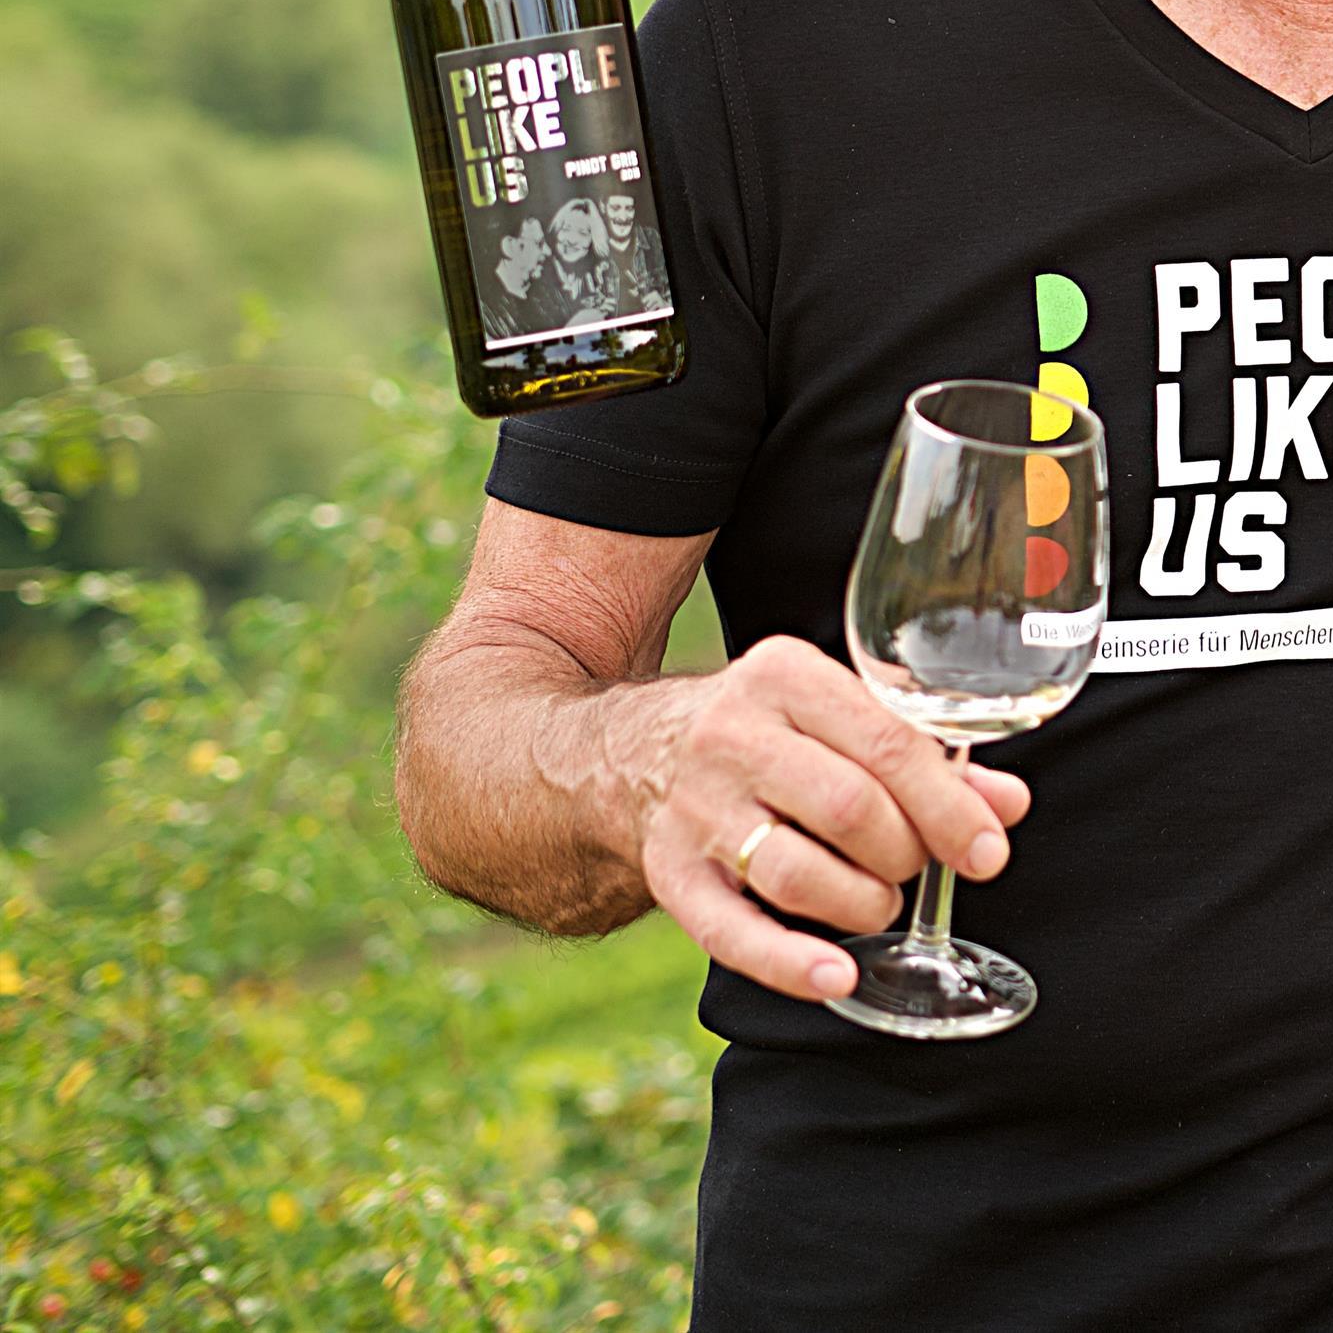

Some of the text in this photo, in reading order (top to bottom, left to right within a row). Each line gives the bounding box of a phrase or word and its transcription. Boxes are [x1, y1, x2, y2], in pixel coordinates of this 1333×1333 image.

[449, 44, 622, 115] PEOPLE
[457, 99, 567, 162] LIKE
[466, 155, 530, 208] US
[564, 155, 607, 179] PINOT
[1139, 491, 1288, 597] US
[1028, 622, 1060, 640] Die
[1198, 630, 1231, 653] für
